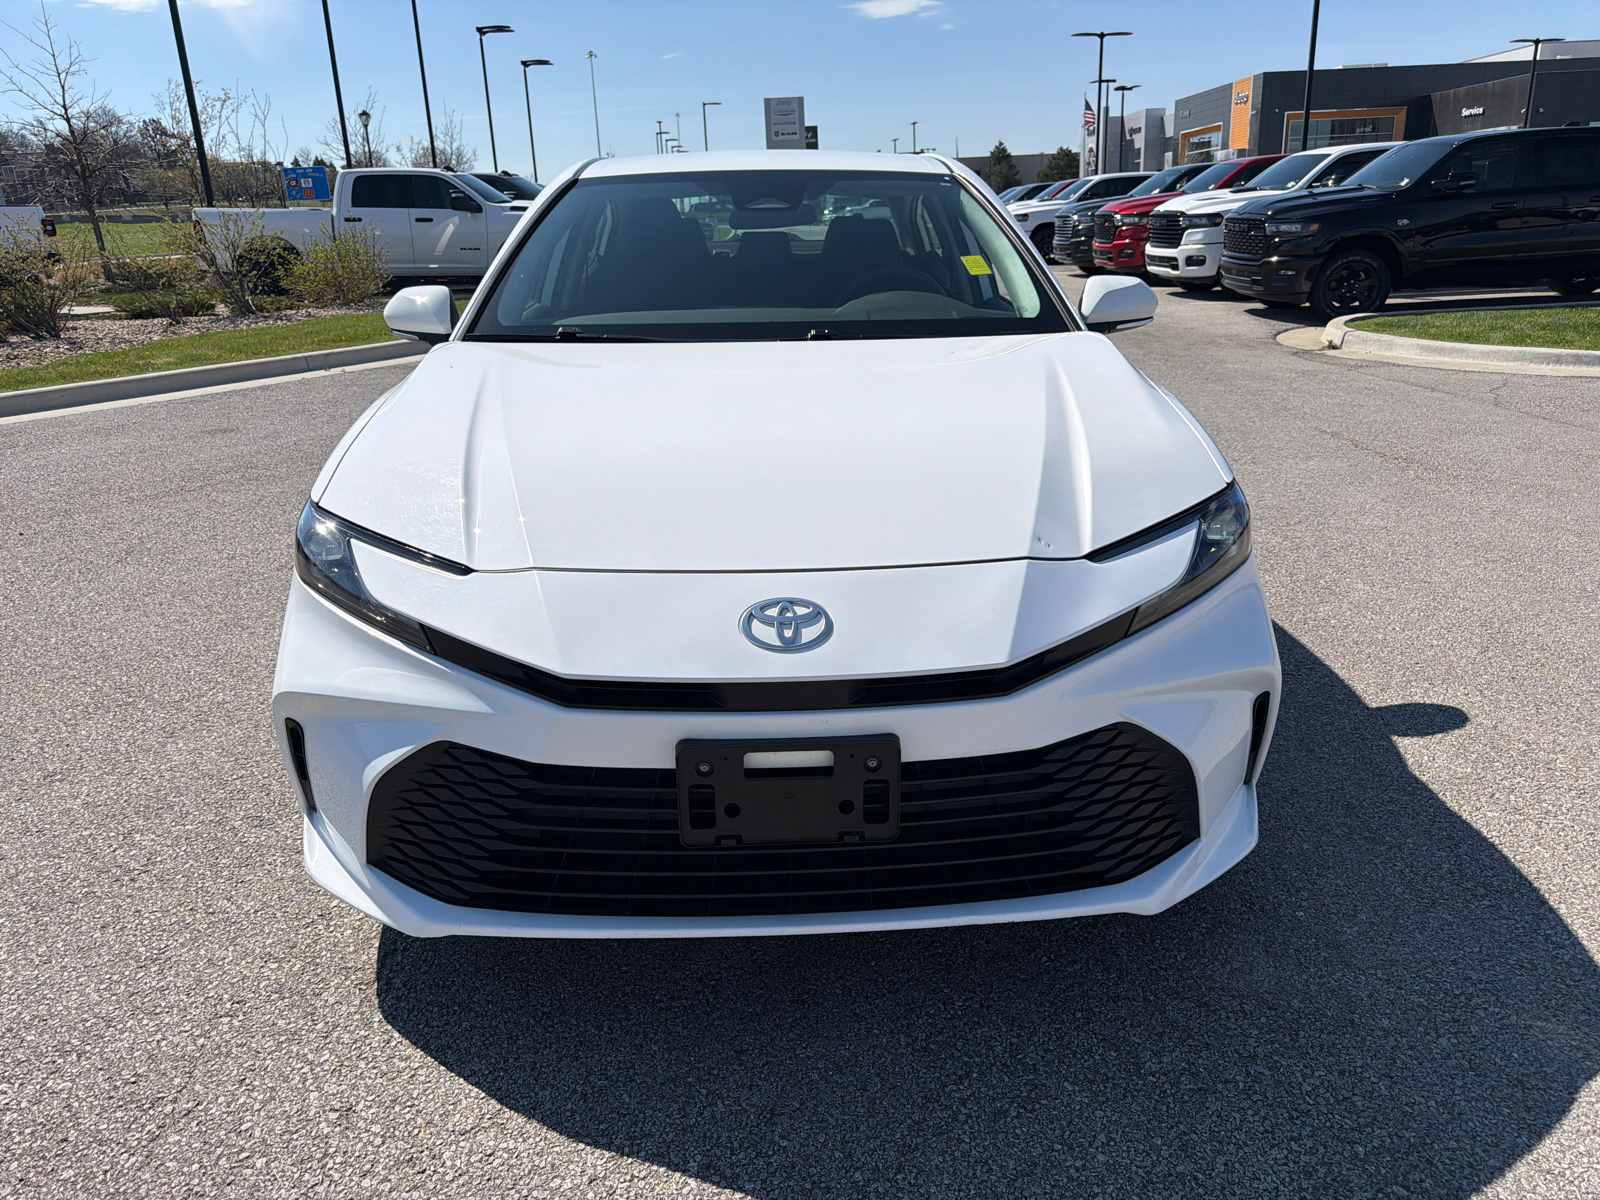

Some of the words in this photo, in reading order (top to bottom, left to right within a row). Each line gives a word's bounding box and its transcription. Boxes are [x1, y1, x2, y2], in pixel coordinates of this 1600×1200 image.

[1233, 92, 1249, 105] Jeep
[1461, 106, 1484, 117] Service
[1226, 223, 1249, 232] RAM
